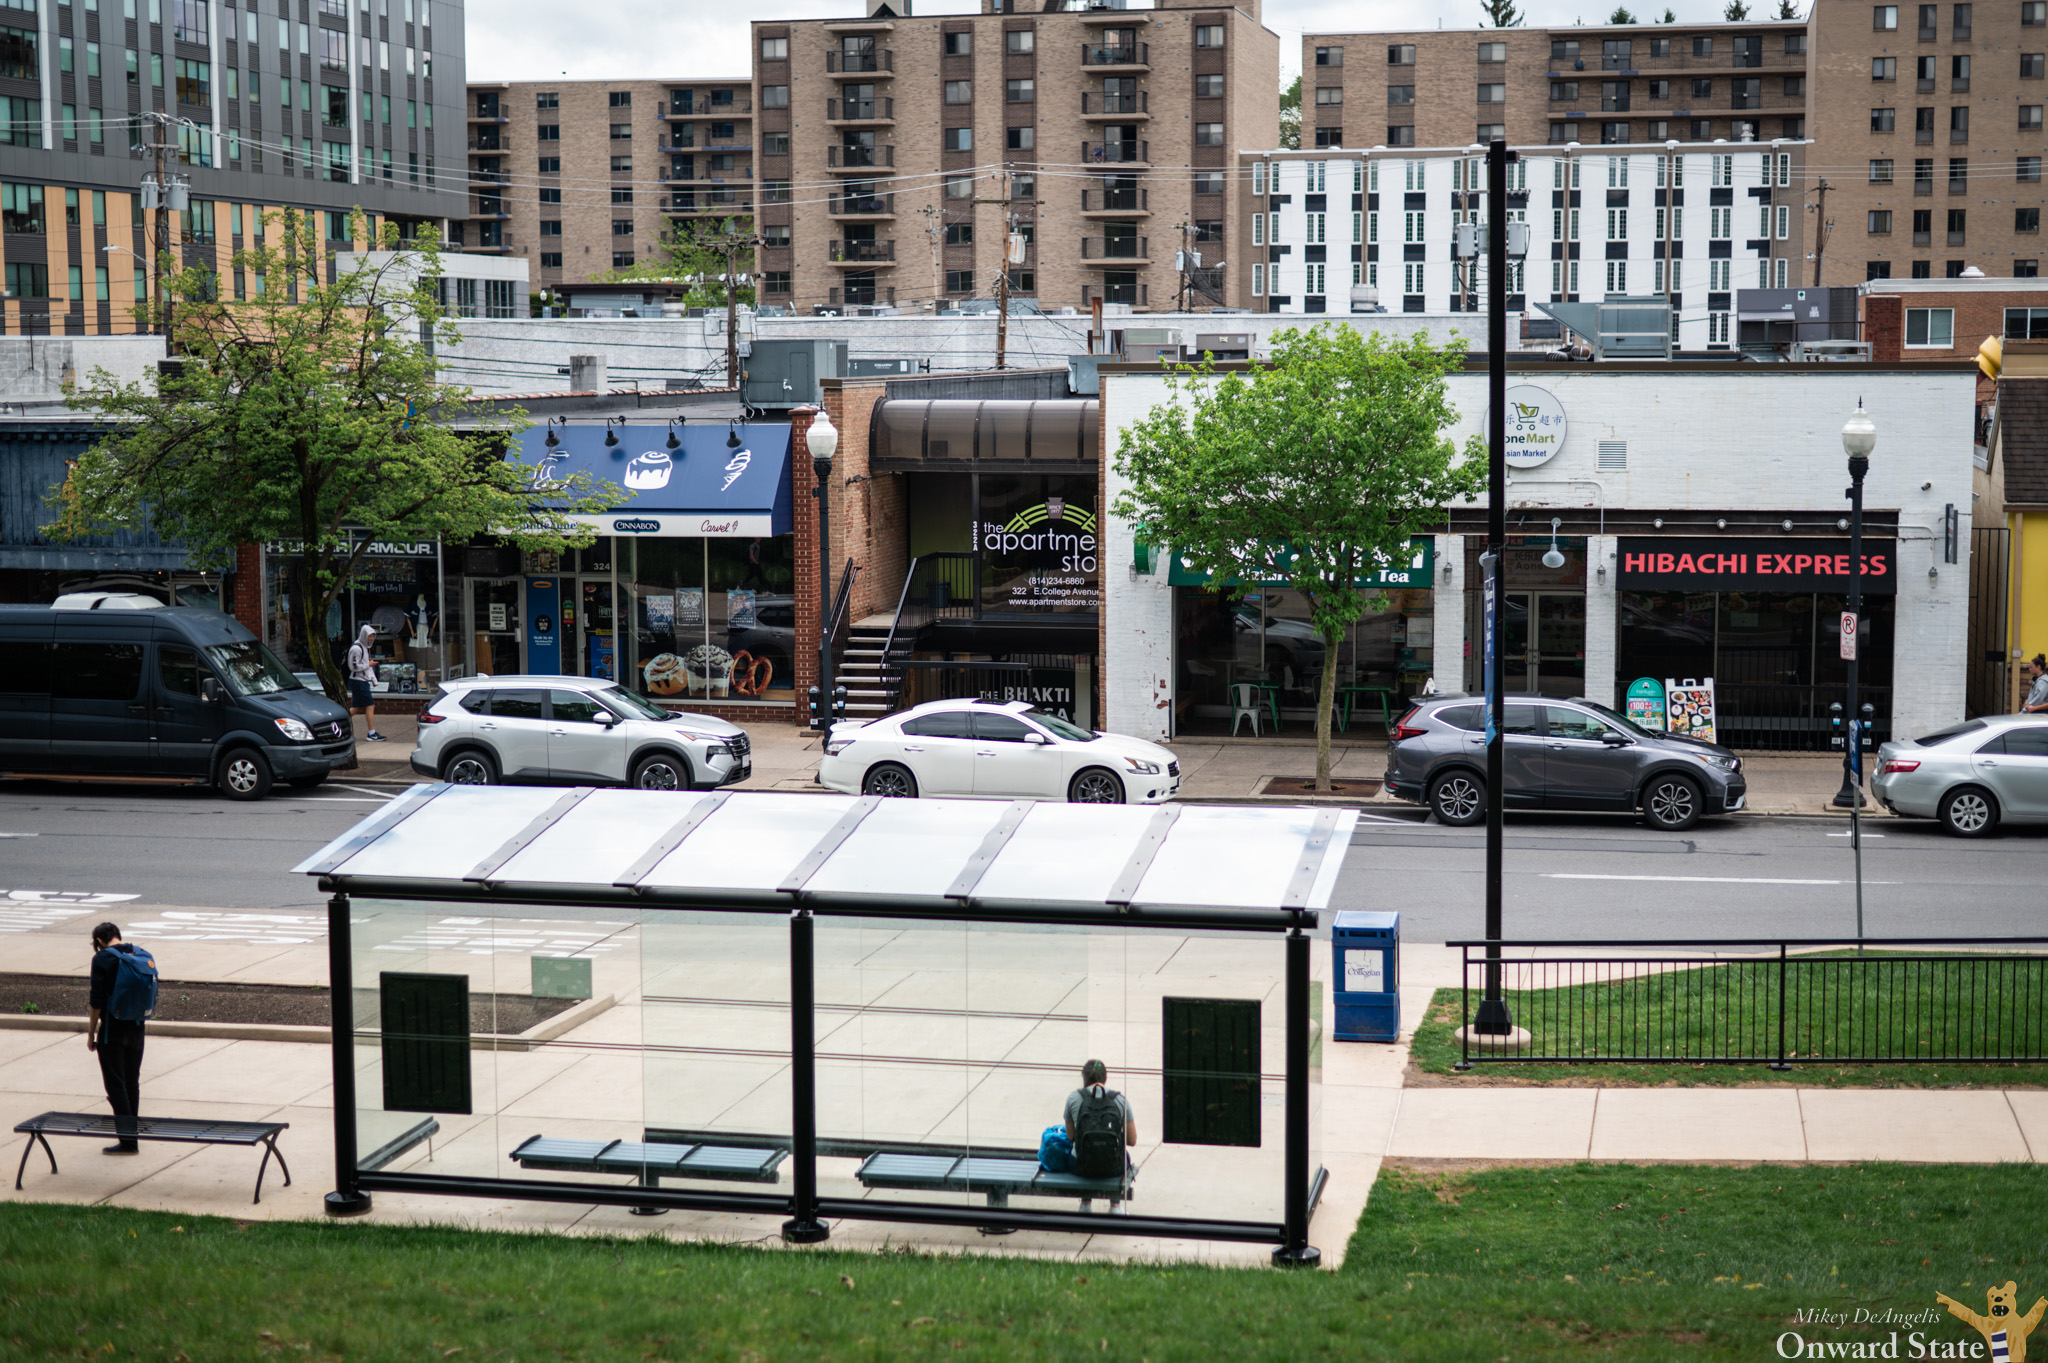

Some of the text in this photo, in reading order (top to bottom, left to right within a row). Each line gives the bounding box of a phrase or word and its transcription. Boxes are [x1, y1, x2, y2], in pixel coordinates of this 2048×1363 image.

[1539, 414, 1563, 426] 超市
[1505, 433, 1555, 444] oneMart
[1505, 449, 1547, 457] sian Market
[615, 521, 658, 530] CINNABON
[700, 519, 729, 533] Carvel
[983, 522, 1004, 534] the
[984, 528, 1096, 555] apartme
[593, 563, 611, 571] 324
[1061, 553, 1097, 573] sto
[1625, 553, 1887, 576] HIBACHI EXPRESS
[1028, 577, 1085, 586] (814)234-6860
[1379, 570, 1410, 583] Tea
[1012, 587, 1027, 595] 322
[1033, 587, 1071, 597] E.College
[980, 687, 1070, 703] THE BHAKTI
[1347, 967, 1381, 978] Collegian
